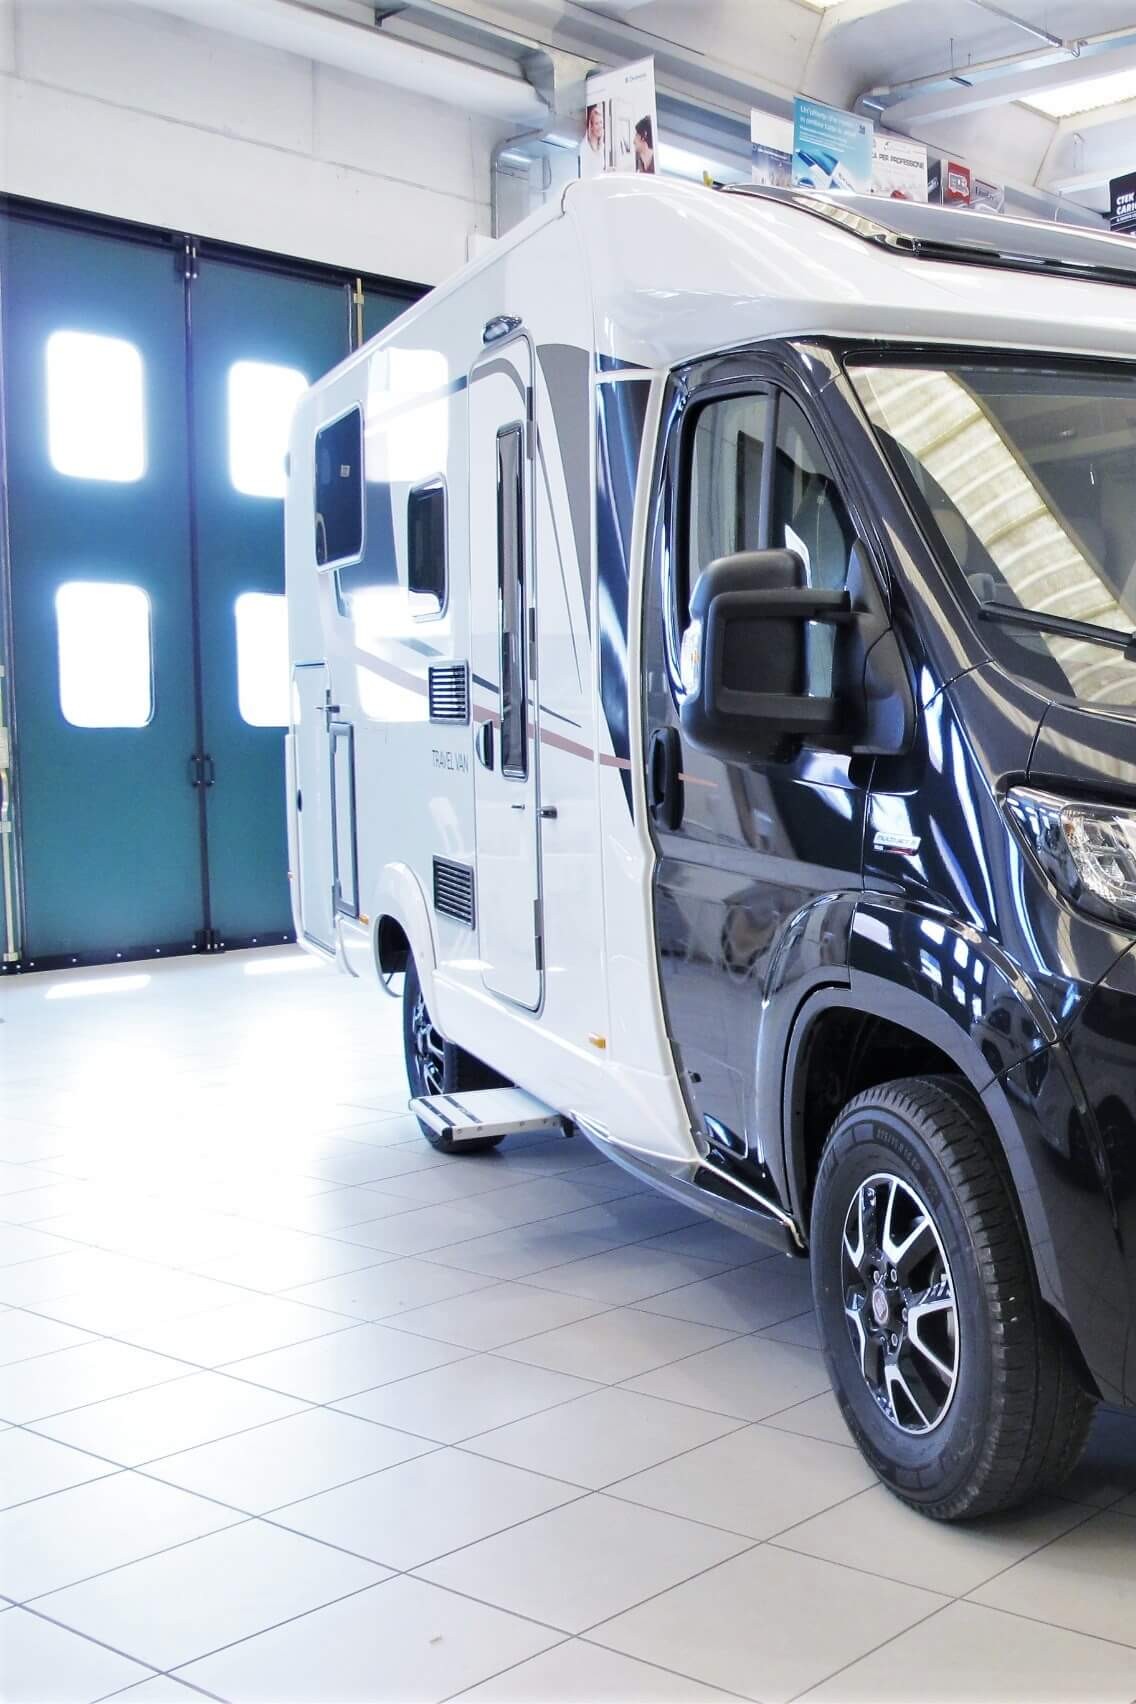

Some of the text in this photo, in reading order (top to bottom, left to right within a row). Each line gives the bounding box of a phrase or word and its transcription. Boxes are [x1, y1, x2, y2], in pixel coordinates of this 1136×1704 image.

[1116, 192, 1135, 205] CTEK
[431, 749, 469, 775] TRAVEL VAN
